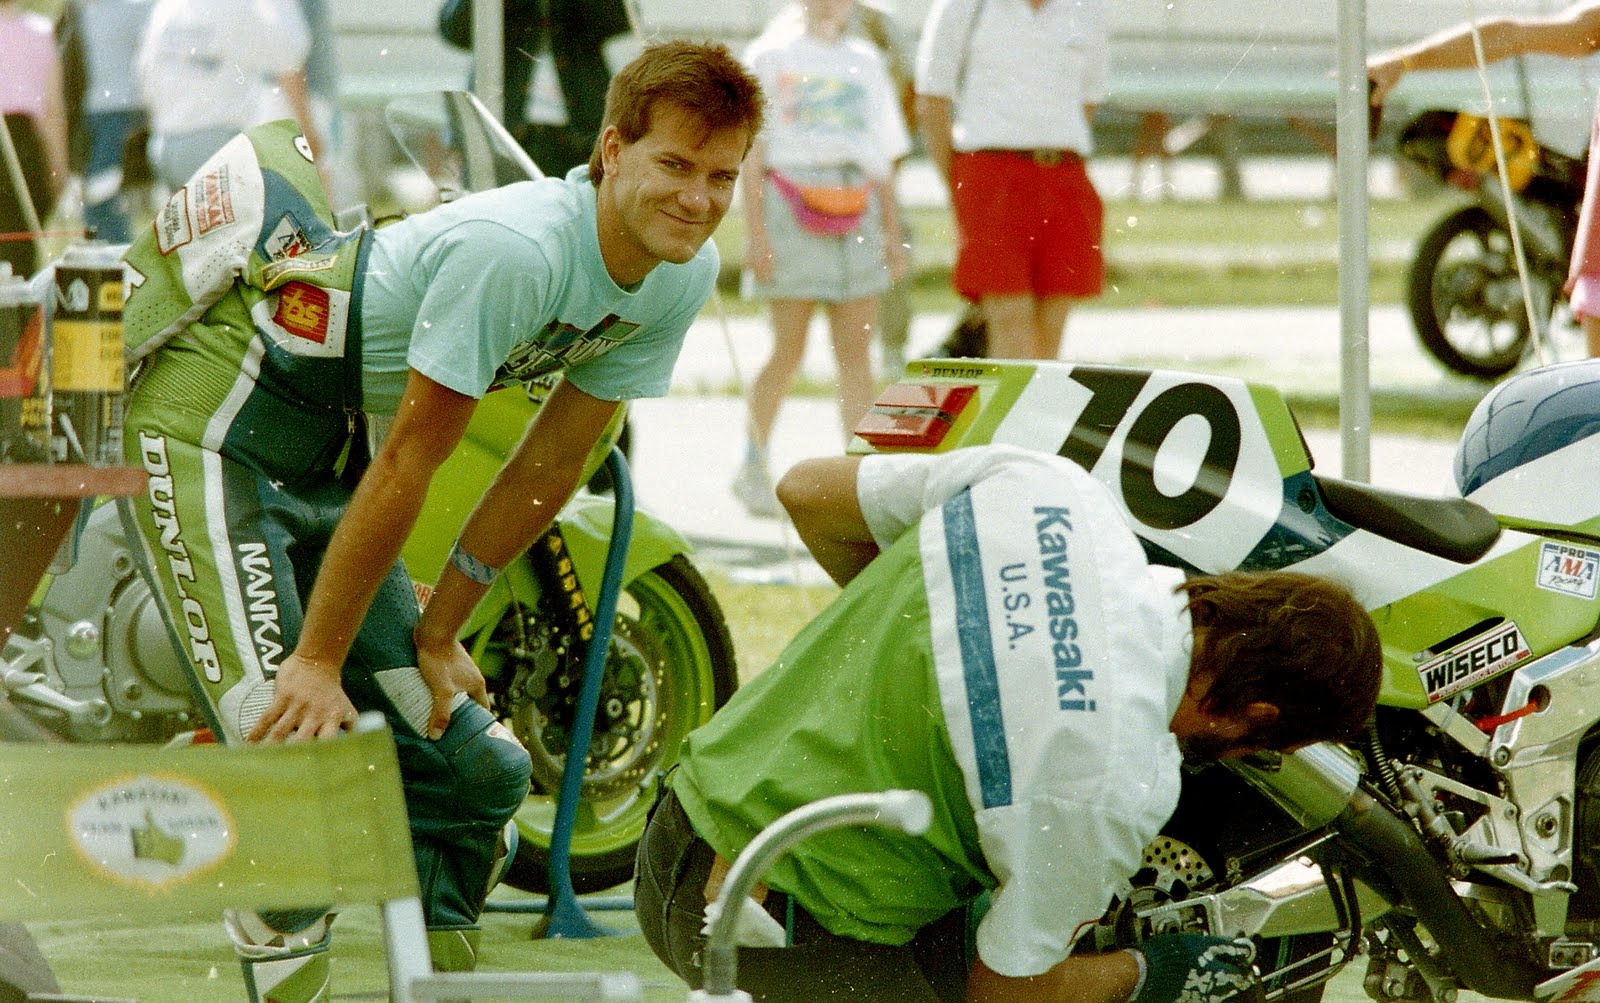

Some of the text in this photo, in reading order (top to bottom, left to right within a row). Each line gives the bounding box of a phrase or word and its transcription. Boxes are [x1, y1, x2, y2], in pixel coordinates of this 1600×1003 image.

[931, 367, 984, 378] DUNLOP
[1057, 366, 1242, 531] 10
[138, 429, 224, 684] DUNLOP
[1545, 556, 1595, 580] AMA
[1560, 546, 1585, 560] PRO
[999, 562, 1035, 651] U.S.A.
[1032, 505, 1097, 713] Kawasaki
[1425, 630, 1519, 694] WISECO
